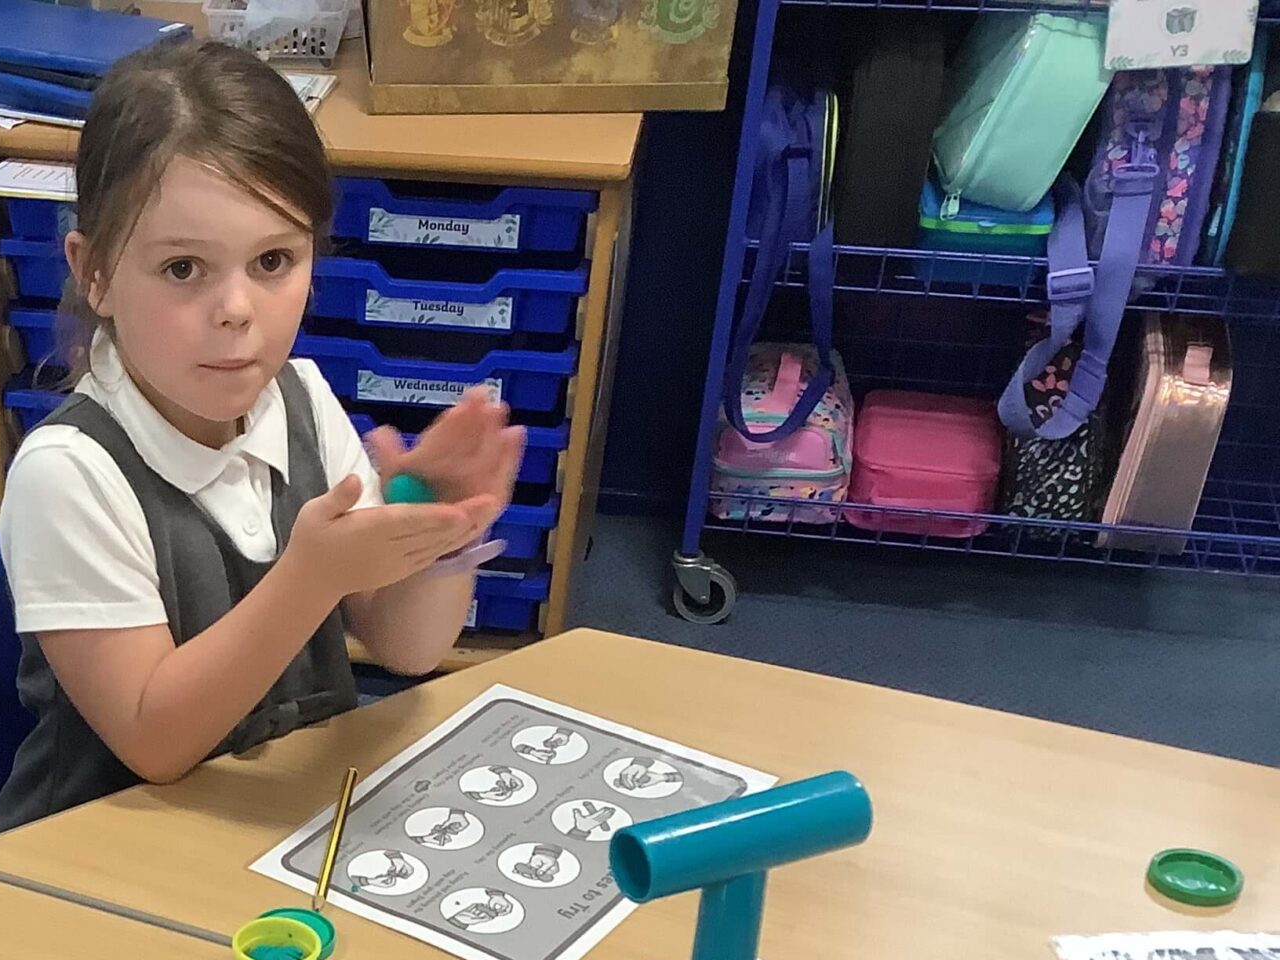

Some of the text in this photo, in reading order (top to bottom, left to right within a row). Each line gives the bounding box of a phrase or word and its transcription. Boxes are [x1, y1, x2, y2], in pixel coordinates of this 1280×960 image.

[1170, 44, 1189, 57] Y3
[417, 219, 470, 236] Monday
[412, 300, 465, 317] Tuesday
[393, 379, 464, 396] Wednesday
[557, 889, 603, 919] to Try
